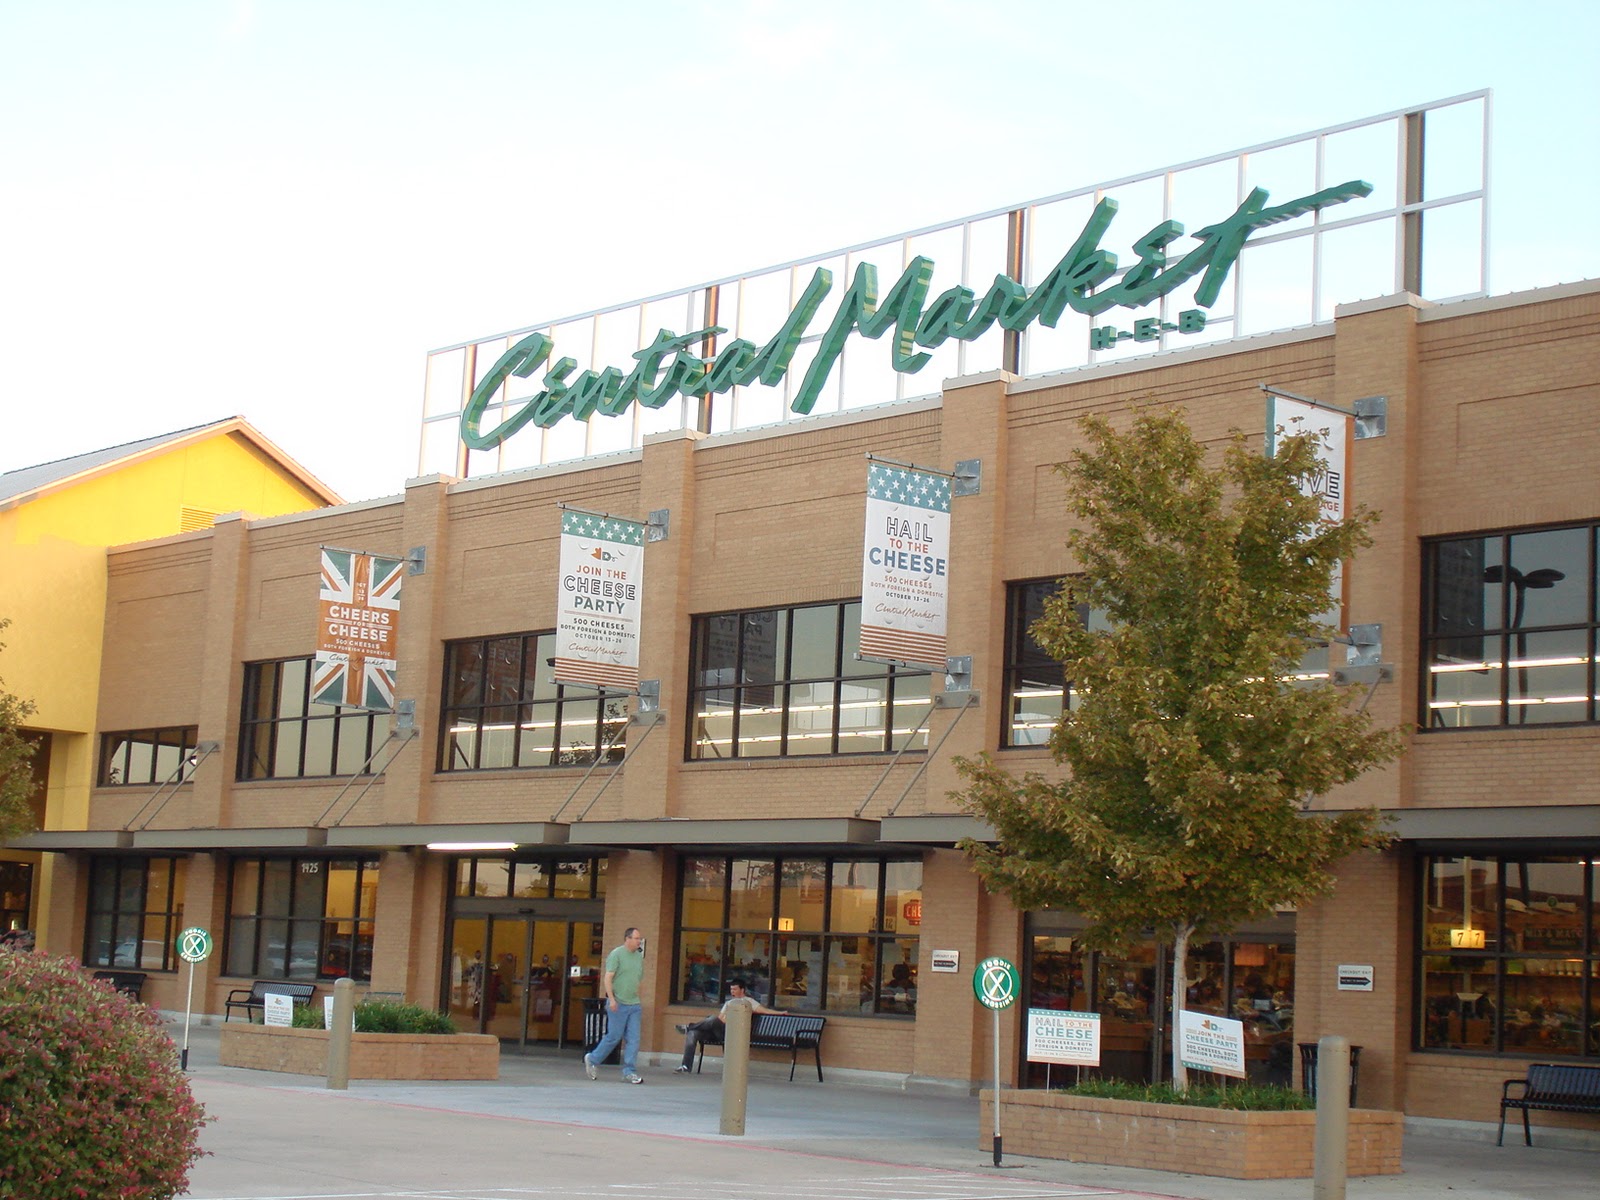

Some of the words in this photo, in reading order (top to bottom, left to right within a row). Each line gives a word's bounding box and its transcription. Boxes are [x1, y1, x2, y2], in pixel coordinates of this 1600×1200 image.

[461, 267, 833, 450] Central
[790, 180, 1374, 414] Market
[1090, 309, 1206, 351] H-E-B
[887, 517, 932, 542] HAIL
[890, 538, 902, 549] TO
[908, 541, 928, 553] THE
[869, 547, 945, 576] CHEESE
[576, 565, 601, 576] JOIN
[607, 569, 626, 580] THE
[564, 575, 635, 600] CHEESE
[899, 578, 932, 588] CHEESES
[886, 592, 911, 600] OCTOBER
[917, 590, 943, 598] DOMESTIC
[574, 596, 625, 614] PARTY
[330, 606, 389, 624] CHEERS
[590, 620, 624, 630] CHEESES
[329, 624, 388, 642] CHEESE
[349, 640, 380, 649] CHEESES
[1458, 932, 1464, 946] 7
[1474, 933, 1480, 945] 7
[982, 960, 1011, 970] FOODIE
[981, 994, 1014, 1009] CROSSING
[1036, 1017, 1063, 1027] HAIL
[1036, 1026, 1092, 1039] CHEESE
[1186, 1034, 1213, 1044] CHEESE
[1216, 1040, 1238, 1048] PARTY
